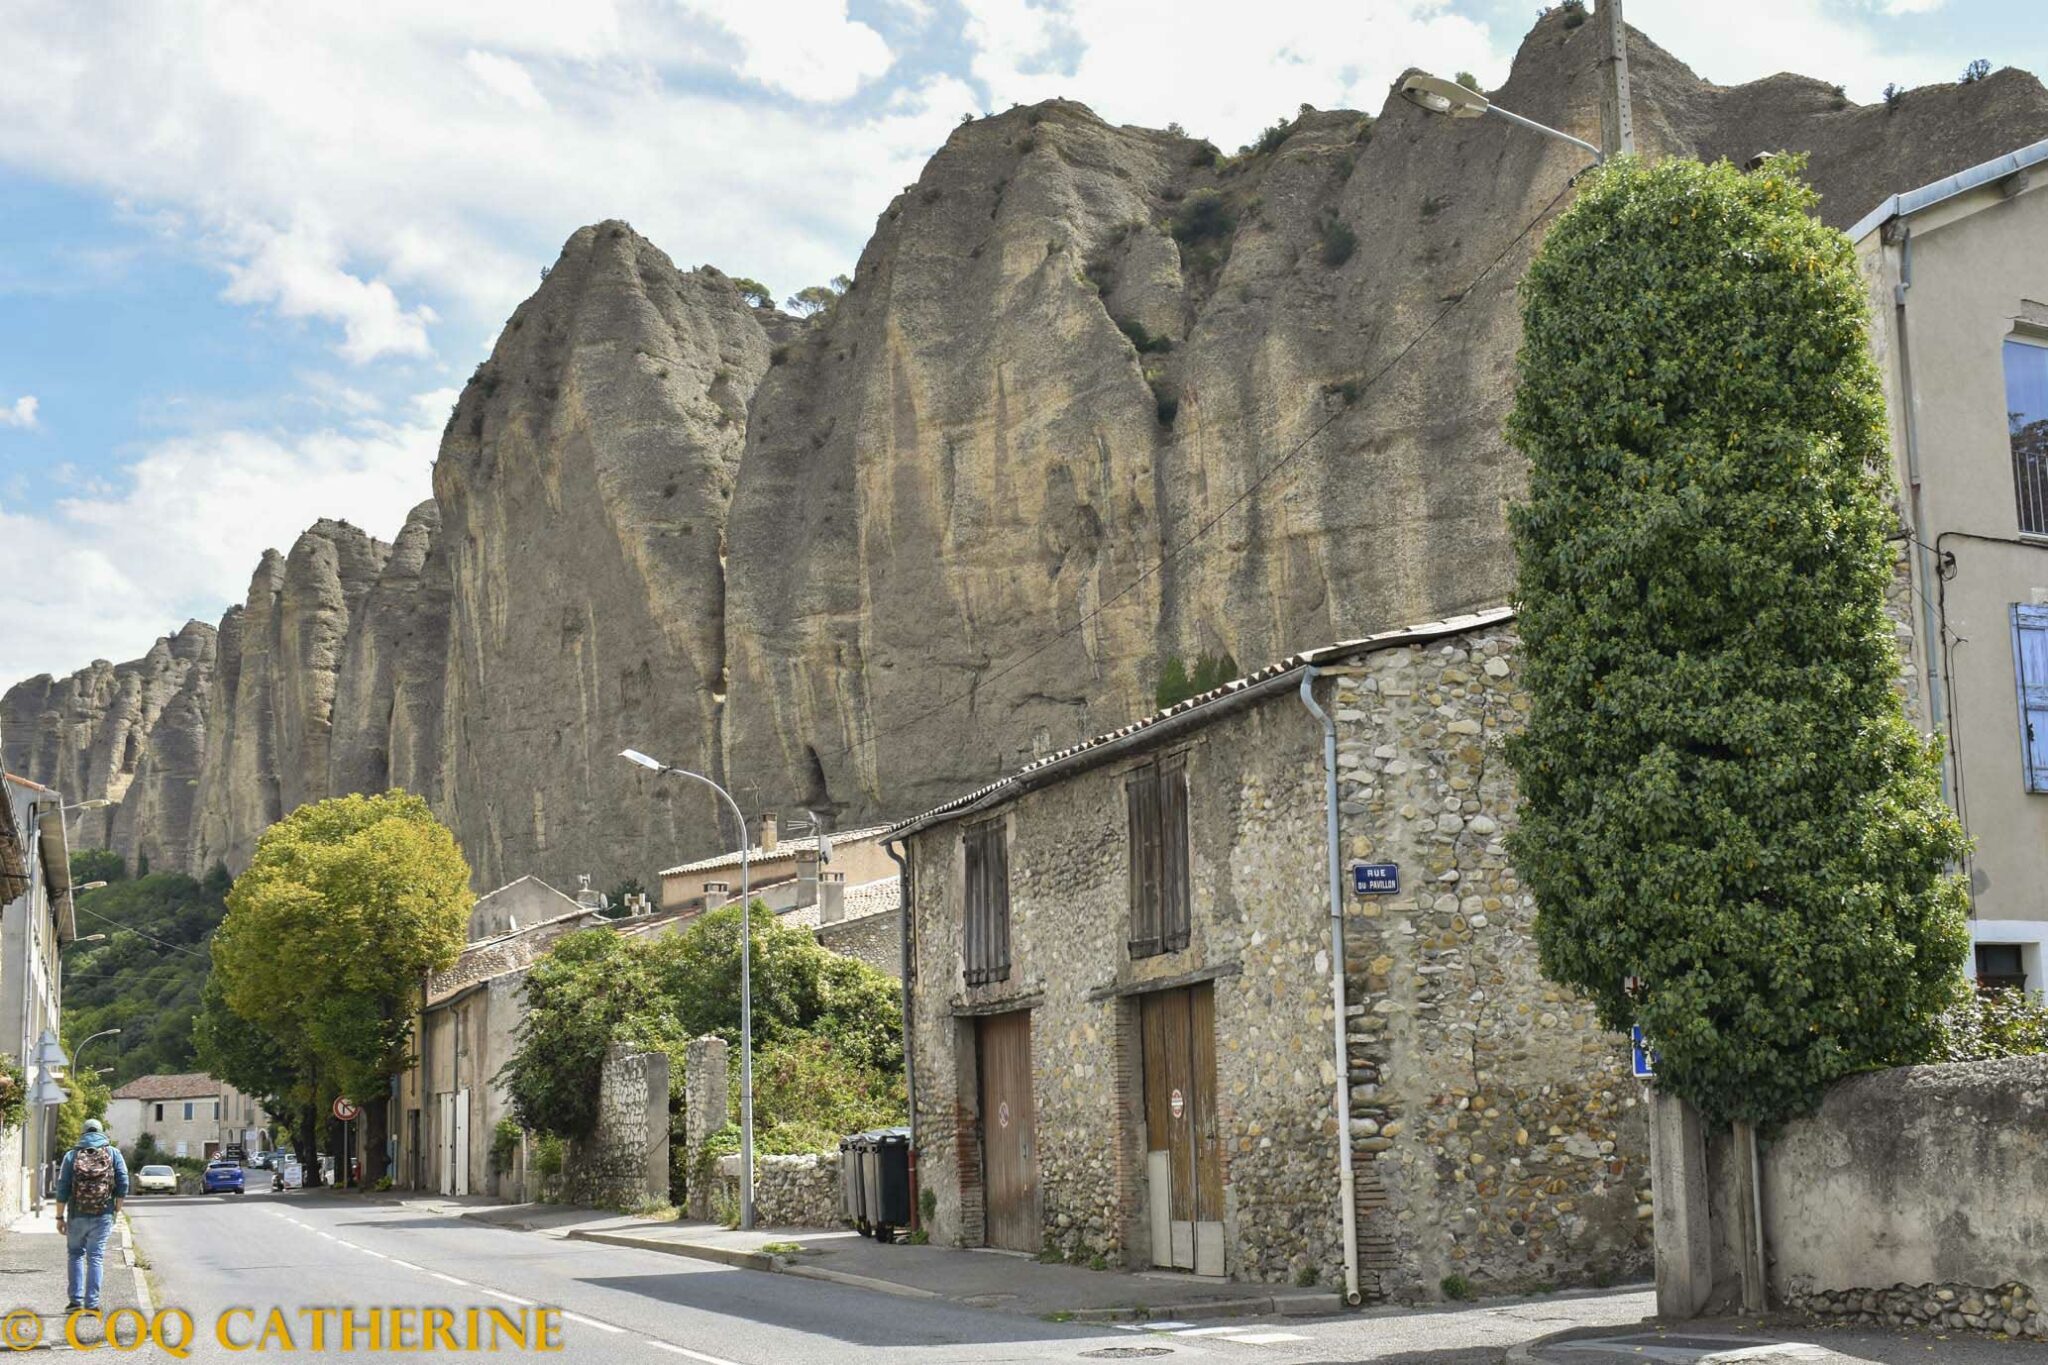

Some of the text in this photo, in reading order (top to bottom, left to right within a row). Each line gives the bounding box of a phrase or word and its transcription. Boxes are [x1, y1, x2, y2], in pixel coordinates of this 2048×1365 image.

[1367, 869, 1386, 877] RUE
[1358, 880, 1396, 890] DU PAVILLON
